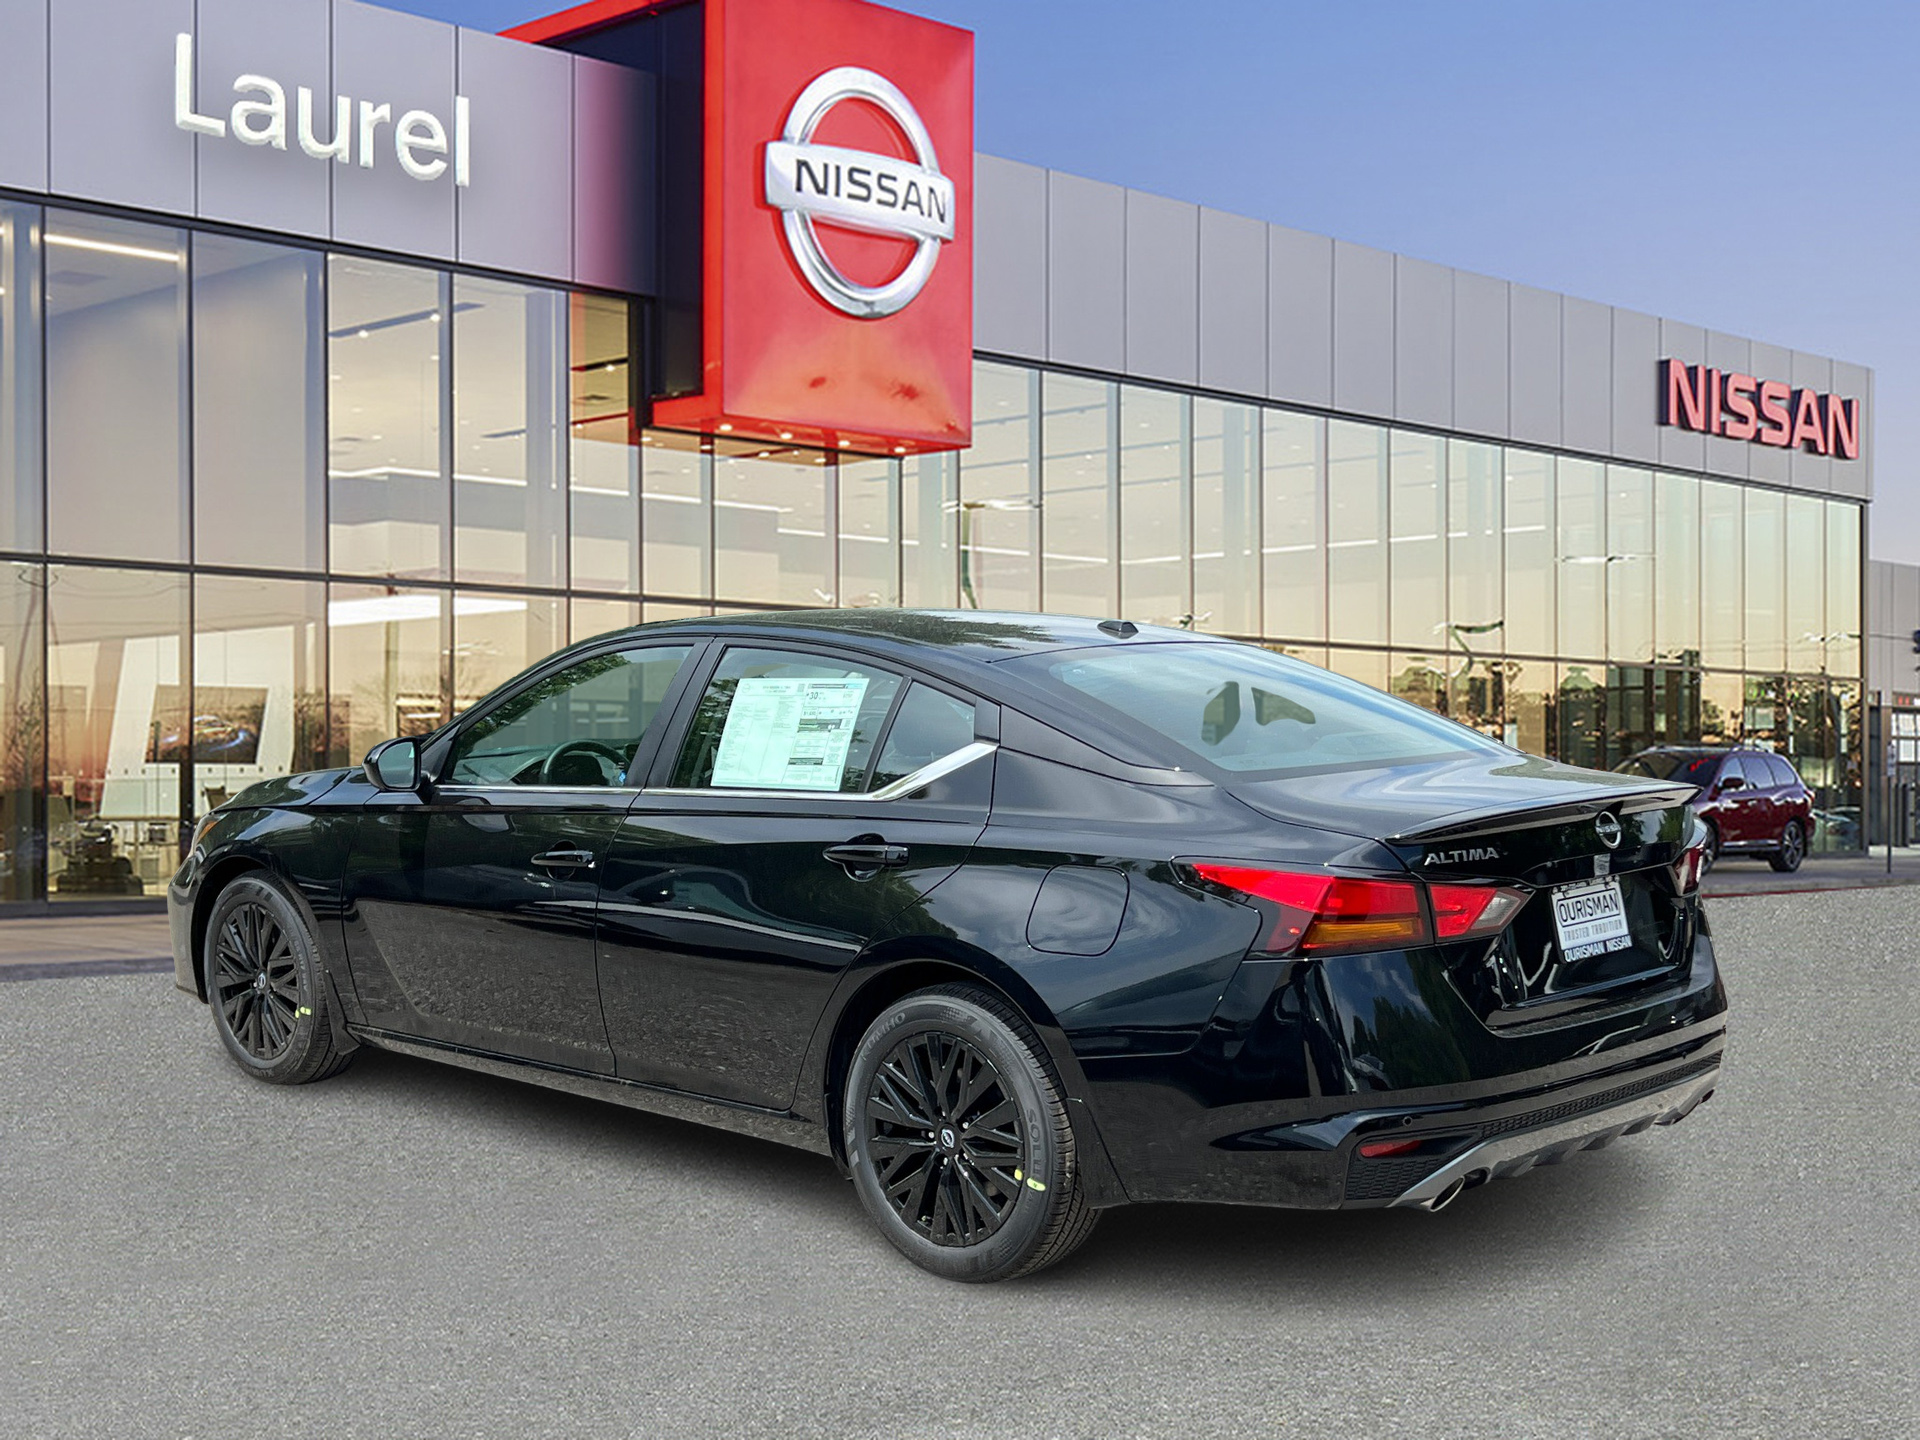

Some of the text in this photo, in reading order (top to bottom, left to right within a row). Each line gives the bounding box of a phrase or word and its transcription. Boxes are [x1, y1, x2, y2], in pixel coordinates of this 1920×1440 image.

[175, 32, 470, 188] Laurel
[794, 158, 947, 224] NISSAN
[1658, 358, 1860, 460] NISSAN
[1423, 846, 1500, 866] ALTIMA
[1558, 893, 1619, 923] OURISMAN
[1563, 918, 1623, 942] TRUSTED TRADITION
[1564, 934, 1633, 962] OURISMAN NISSAN
[1026, 1108, 1043, 1181] SOLU
